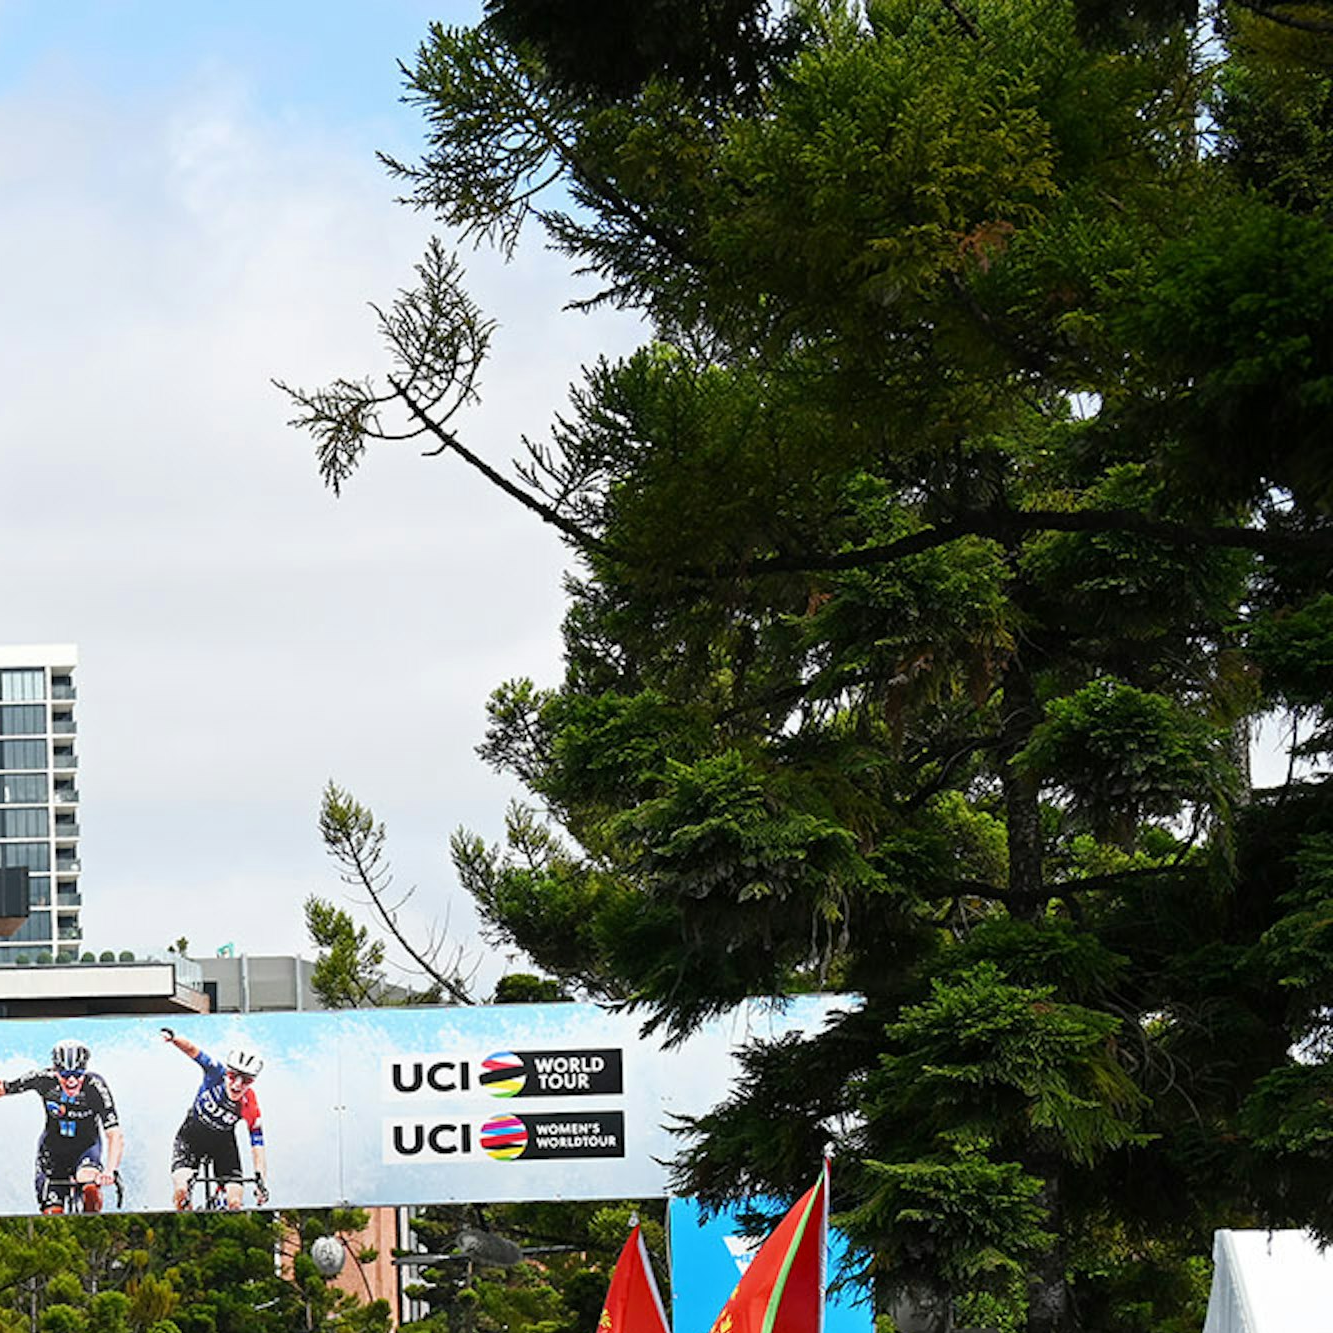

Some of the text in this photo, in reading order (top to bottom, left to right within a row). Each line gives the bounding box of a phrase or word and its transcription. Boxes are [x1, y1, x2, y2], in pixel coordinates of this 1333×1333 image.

[534, 1057, 605, 1074] WORLD
[392, 1061, 470, 1093] UCI
[538, 1073, 591, 1090] TOUR
[536, 1122, 601, 1136] WOMEN'S
[393, 1123, 472, 1156] UCI
[536, 1134, 617, 1149] WORLDTOUR
